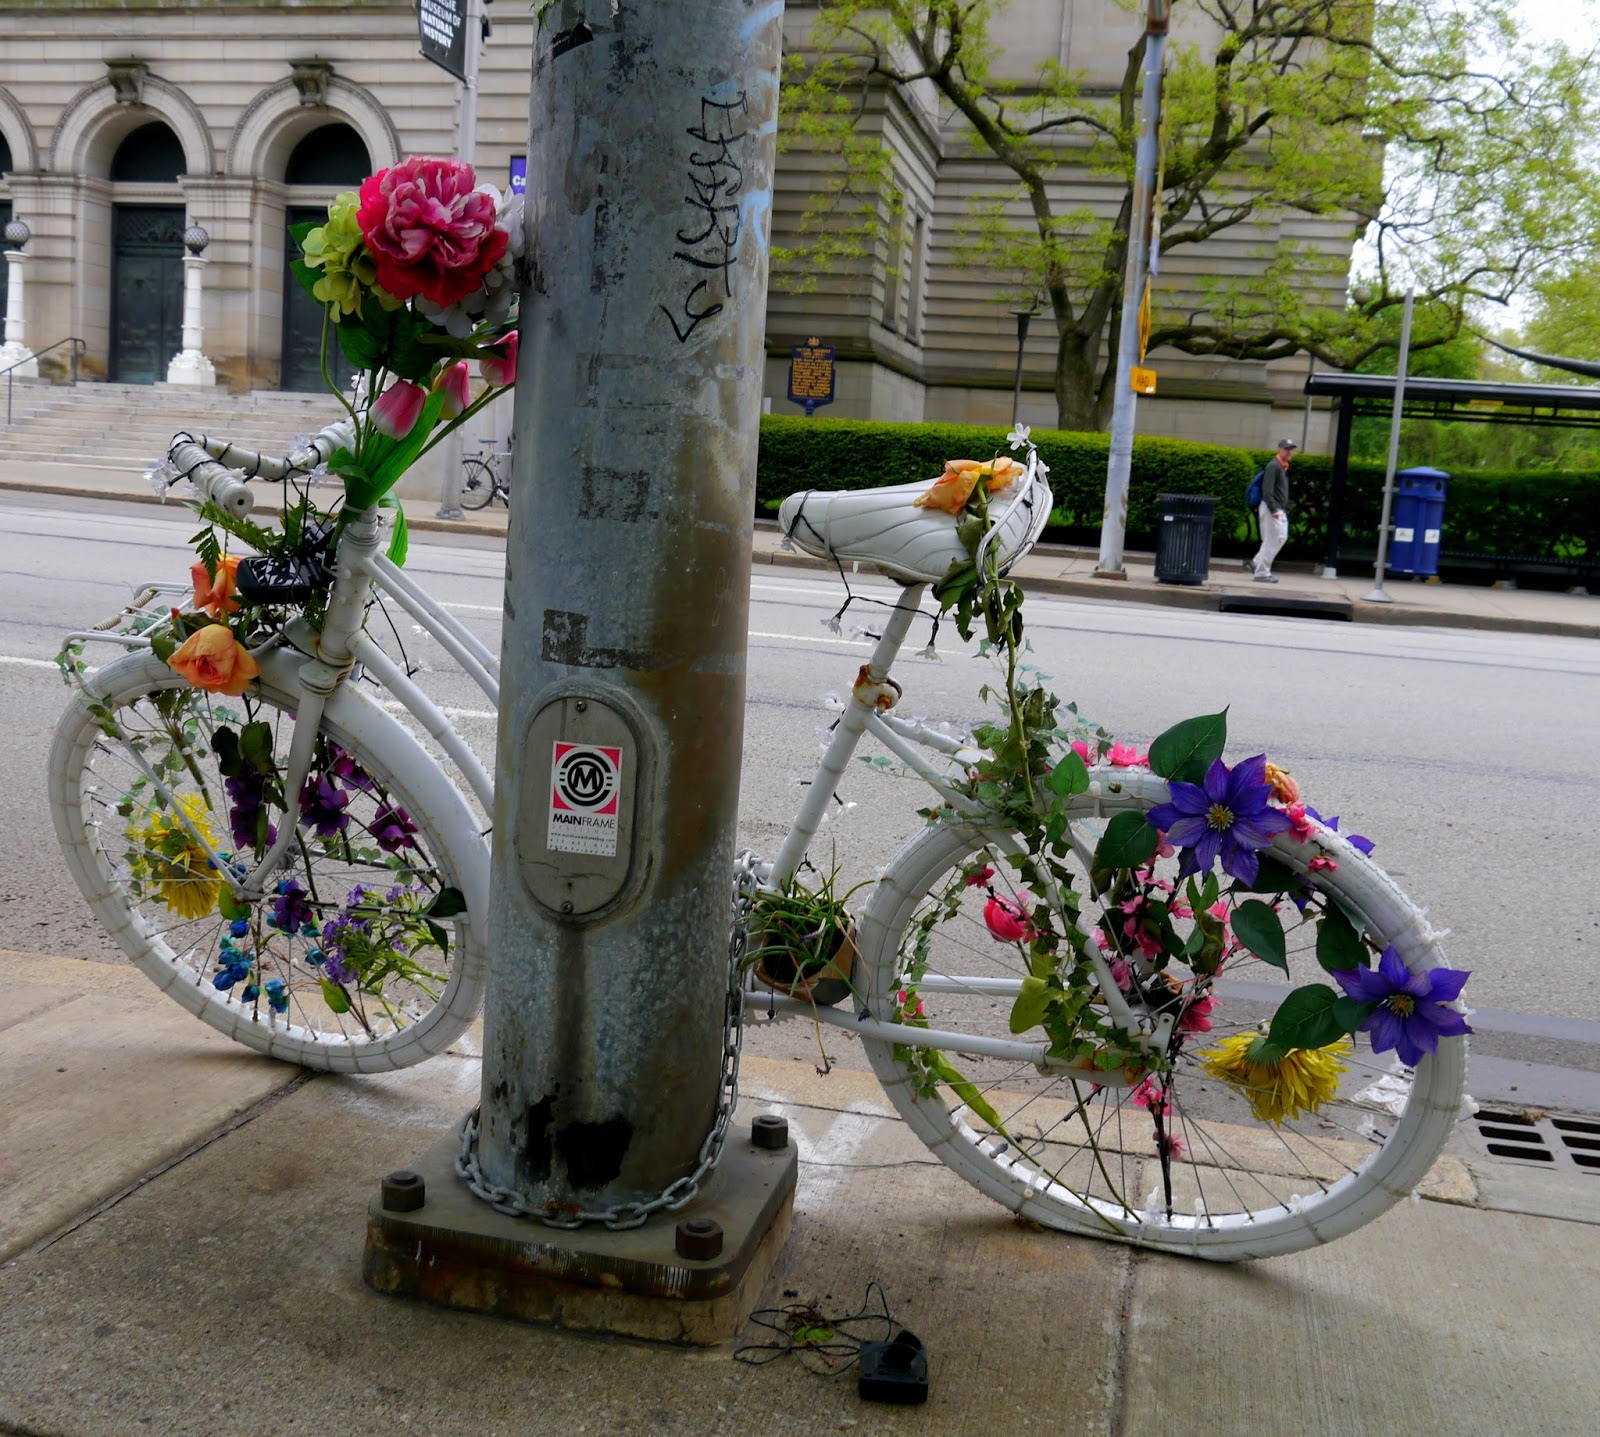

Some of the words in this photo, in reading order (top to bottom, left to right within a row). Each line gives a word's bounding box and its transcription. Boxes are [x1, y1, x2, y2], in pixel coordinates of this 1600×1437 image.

[420, 0, 452, 23] MUSEUM
[453, 14, 461, 28] OF
[420, 9, 454, 38] NATURAL
[423, 23, 452, 48] HISTORY
[552, 813, 615, 829] MAINFRAME
